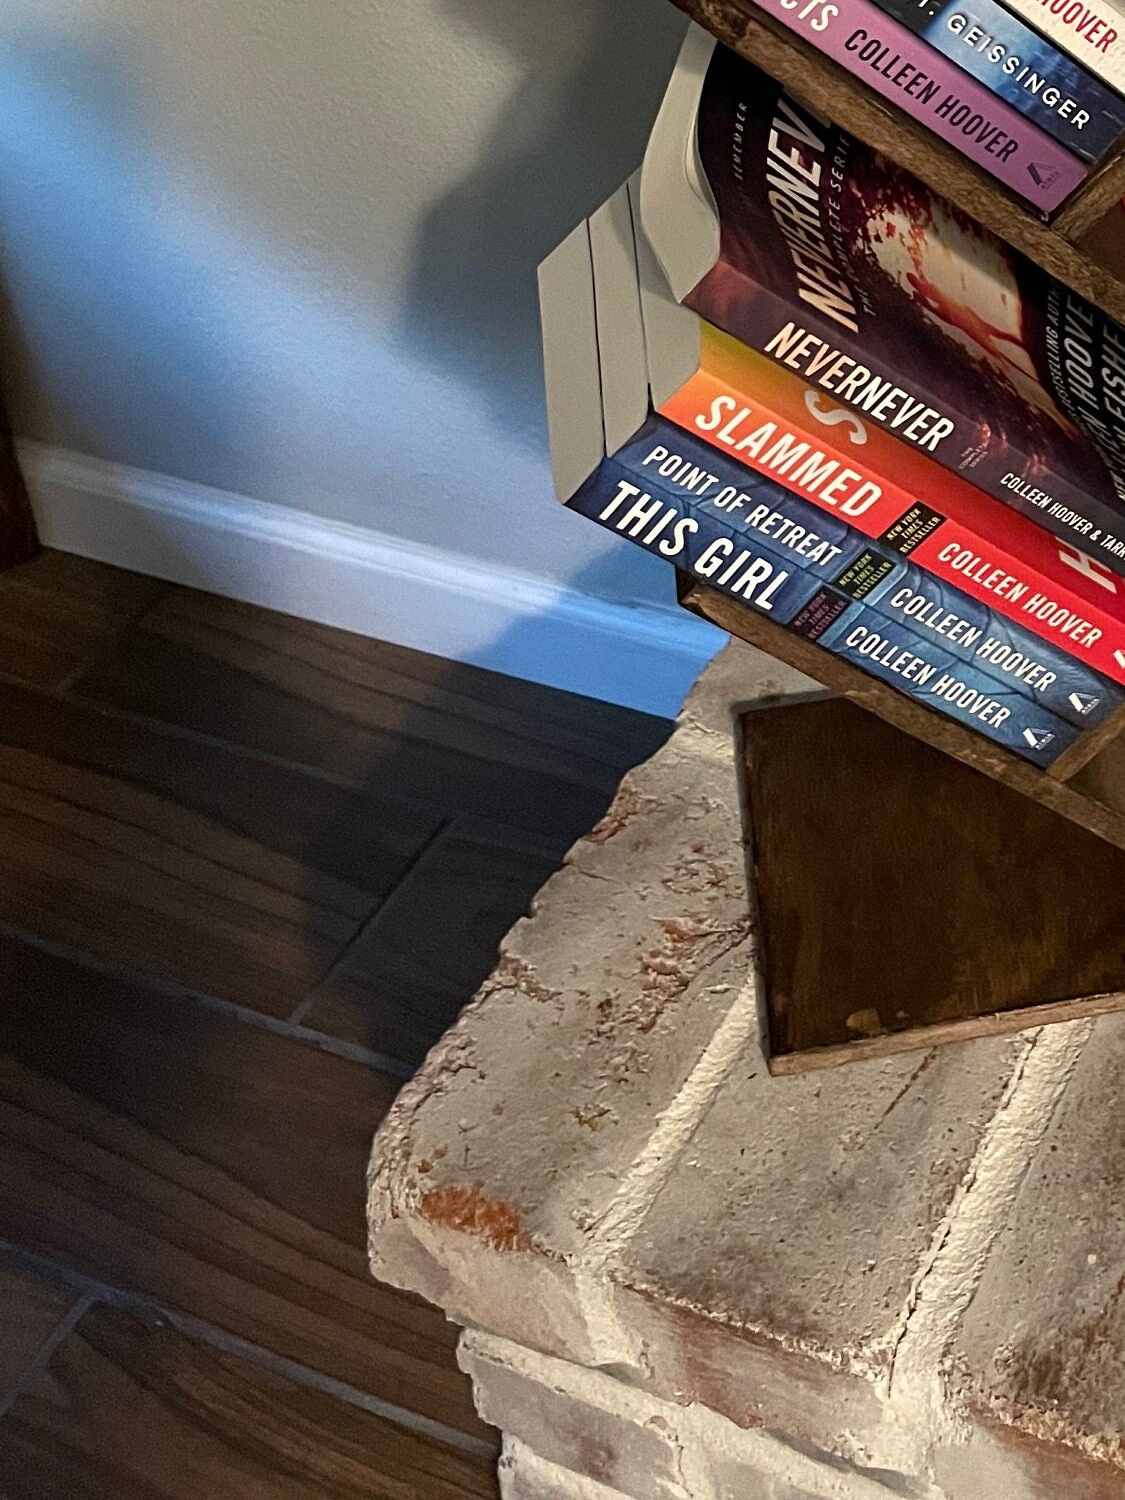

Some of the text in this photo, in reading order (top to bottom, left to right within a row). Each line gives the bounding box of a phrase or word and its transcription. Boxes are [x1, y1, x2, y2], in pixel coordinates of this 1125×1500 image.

[844, 28, 1018, 163] COLLEEN HOOVER
[947, 14, 1092, 132] GEISSINGER
[766, 98, 859, 333] NEVERNEV
[829, 134, 851, 192] SERIE
[763, 321, 955, 453] NEVERNEVER
[1064, 295, 1100, 411] HOOVE
[642, 445, 843, 568] POINT OF RETREAT
[696, 394, 883, 518] SLAMMED
[1000, 472, 1052, 510] COLLEEN
[1048, 501, 1094, 535] HOOVER
[1089, 529, 1102, 541] &
[599, 480, 791, 612] THIS GIRL
[838, 552, 872, 587] NEW YORK
[853, 565, 875, 585] TIMES
[886, 507, 922, 541] NEW YORK
[900, 516, 941, 554] BESTSELLER
[901, 518, 924, 540] TIMES
[852, 561, 892, 599] BESTSELLER
[937, 542, 1031, 614] COLLEEN
[1020, 586, 1104, 650] HOOVER
[845, 625, 1012, 730] COLLEEN HOOVER
[890, 587, 1057, 693] COLLEEN HOOVER
